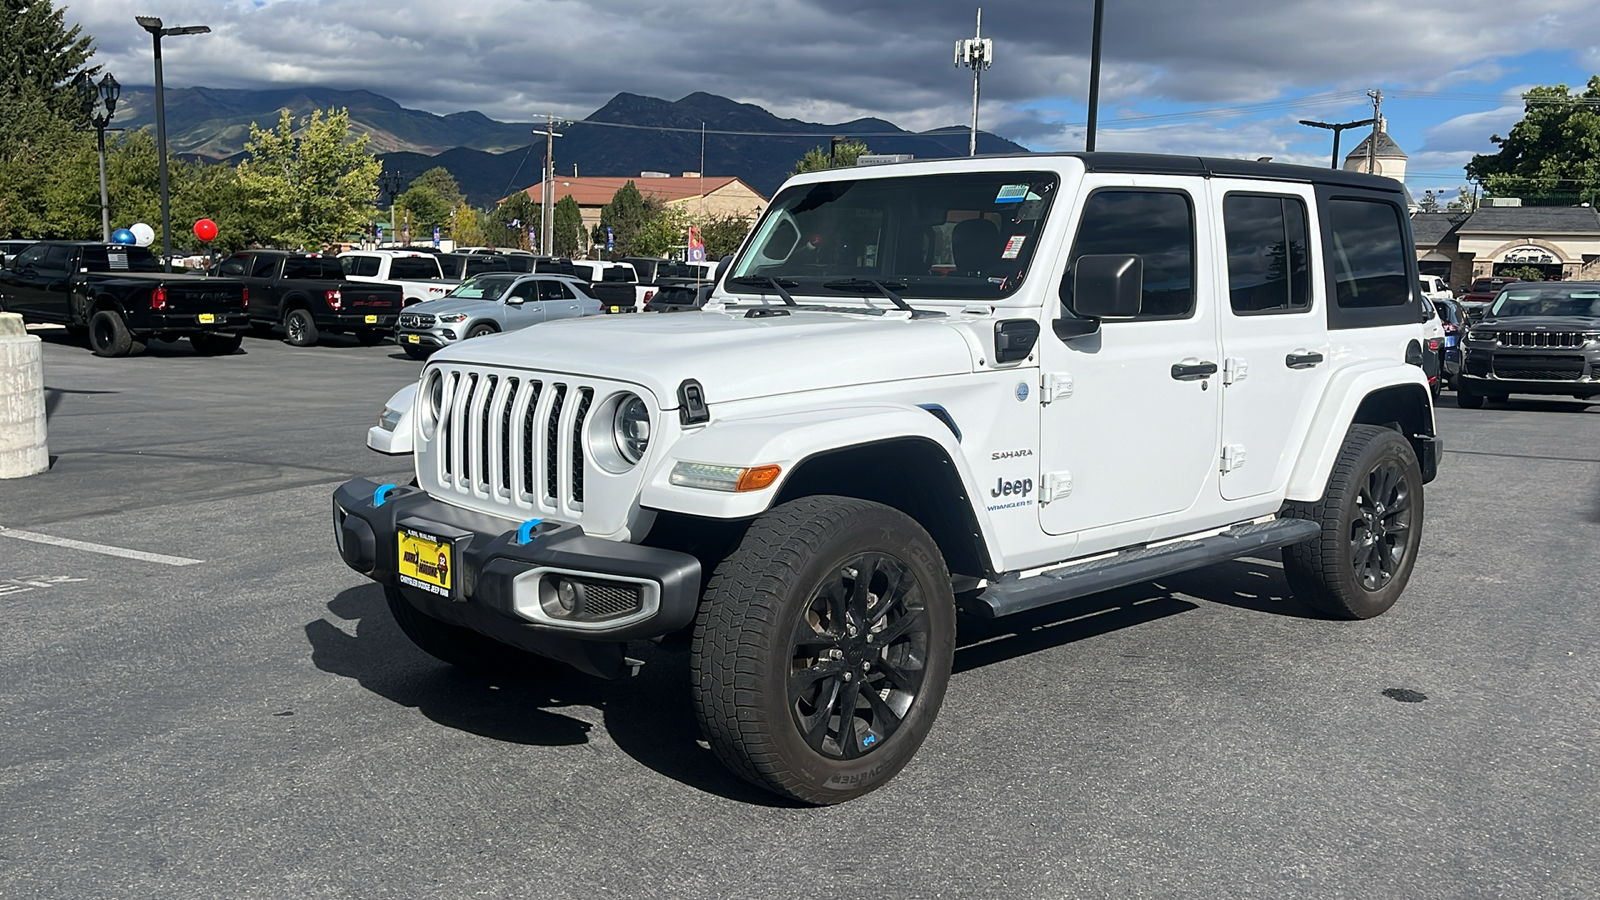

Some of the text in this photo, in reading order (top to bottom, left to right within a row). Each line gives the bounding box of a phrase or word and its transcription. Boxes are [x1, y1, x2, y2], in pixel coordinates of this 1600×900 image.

[992, 449, 1033, 460] SAHARA
[991, 478, 1032, 498] Jeep
[987, 501, 1025, 511] WRANGLER
[419, 581, 431, 591] DODGE
[431, 585, 439, 594] JEEP
